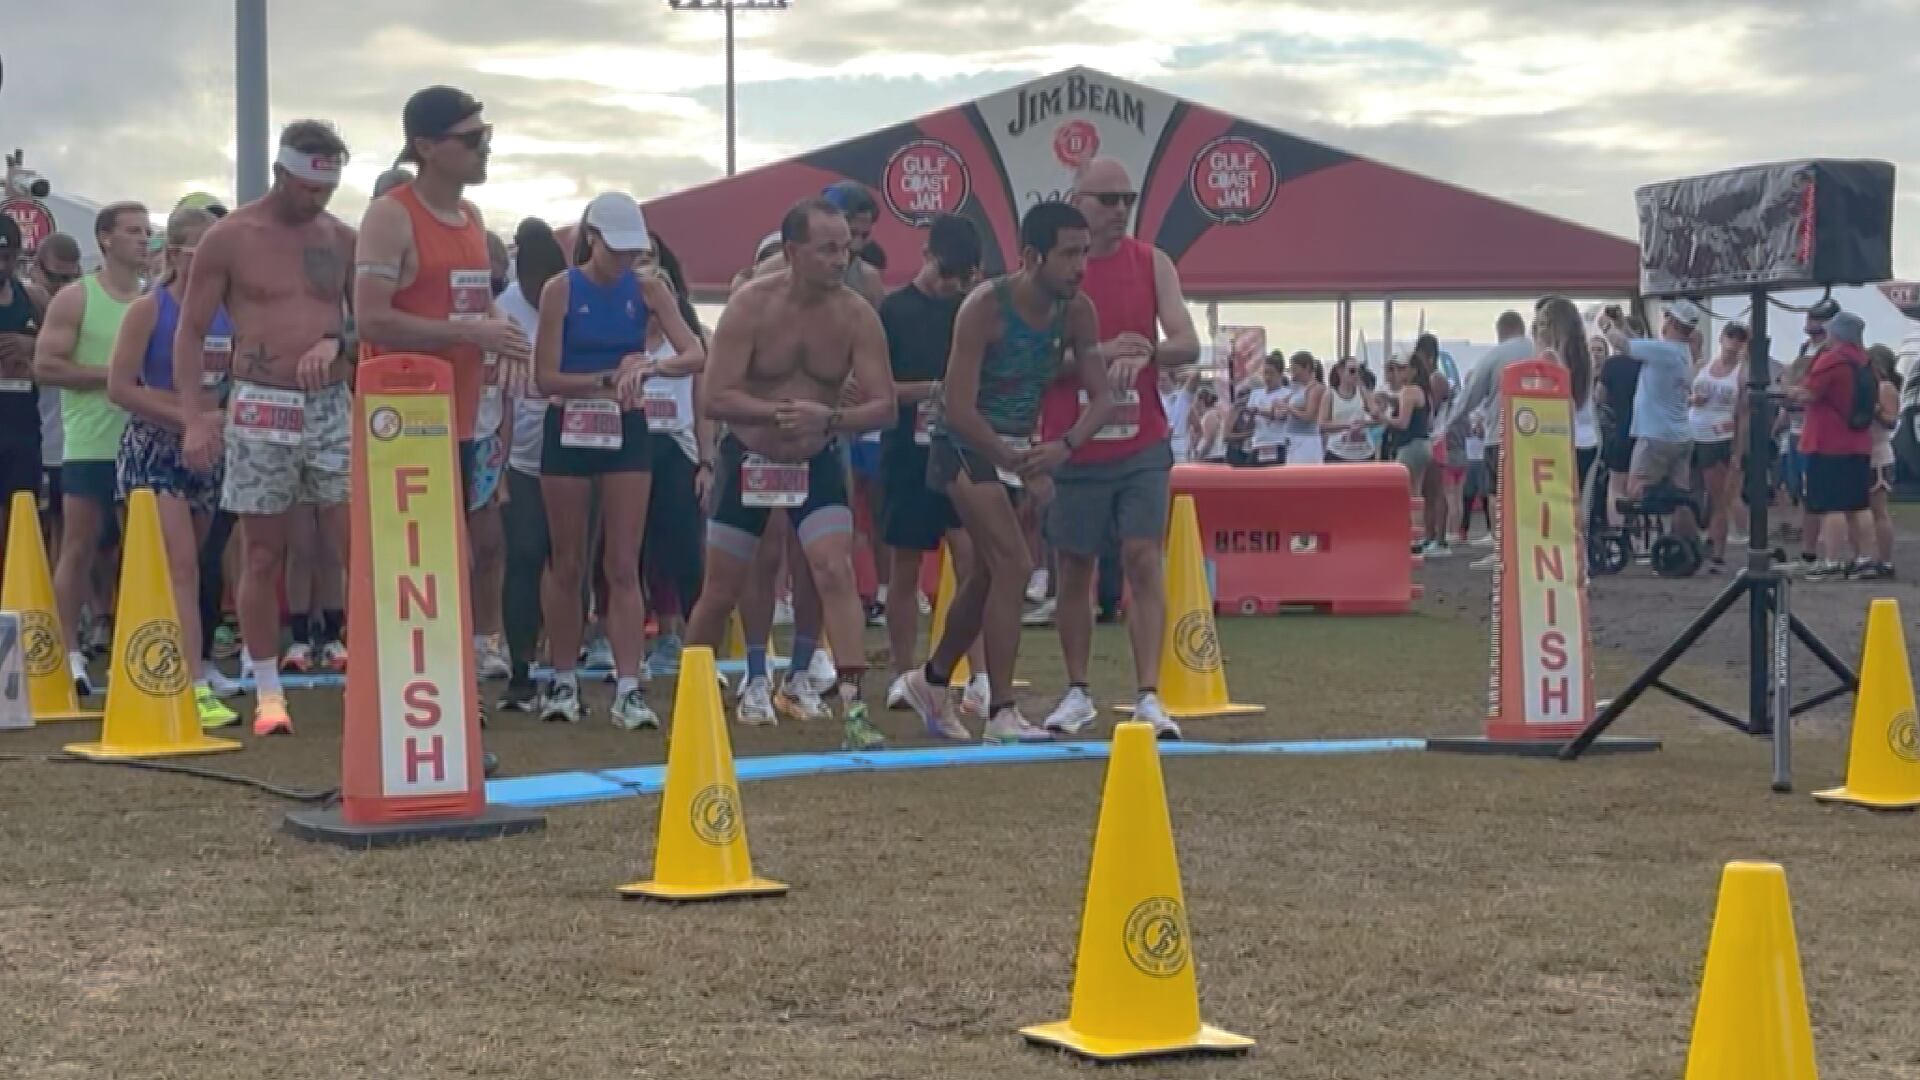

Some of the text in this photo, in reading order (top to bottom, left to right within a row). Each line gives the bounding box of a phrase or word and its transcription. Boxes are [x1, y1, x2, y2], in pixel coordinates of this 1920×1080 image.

[1008, 74, 1146, 136] JIM BEAM
[903, 156, 949, 174] GULF
[1210, 152, 1257, 171] GULF
[901, 175, 951, 192] COAST
[1208, 171, 1258, 188] COAST
[911, 191, 942, 210] JAM
[1218, 188, 1250, 207] JAM
[1531, 458, 1569, 714] FINISH
[395, 467, 445, 782] FINISH
